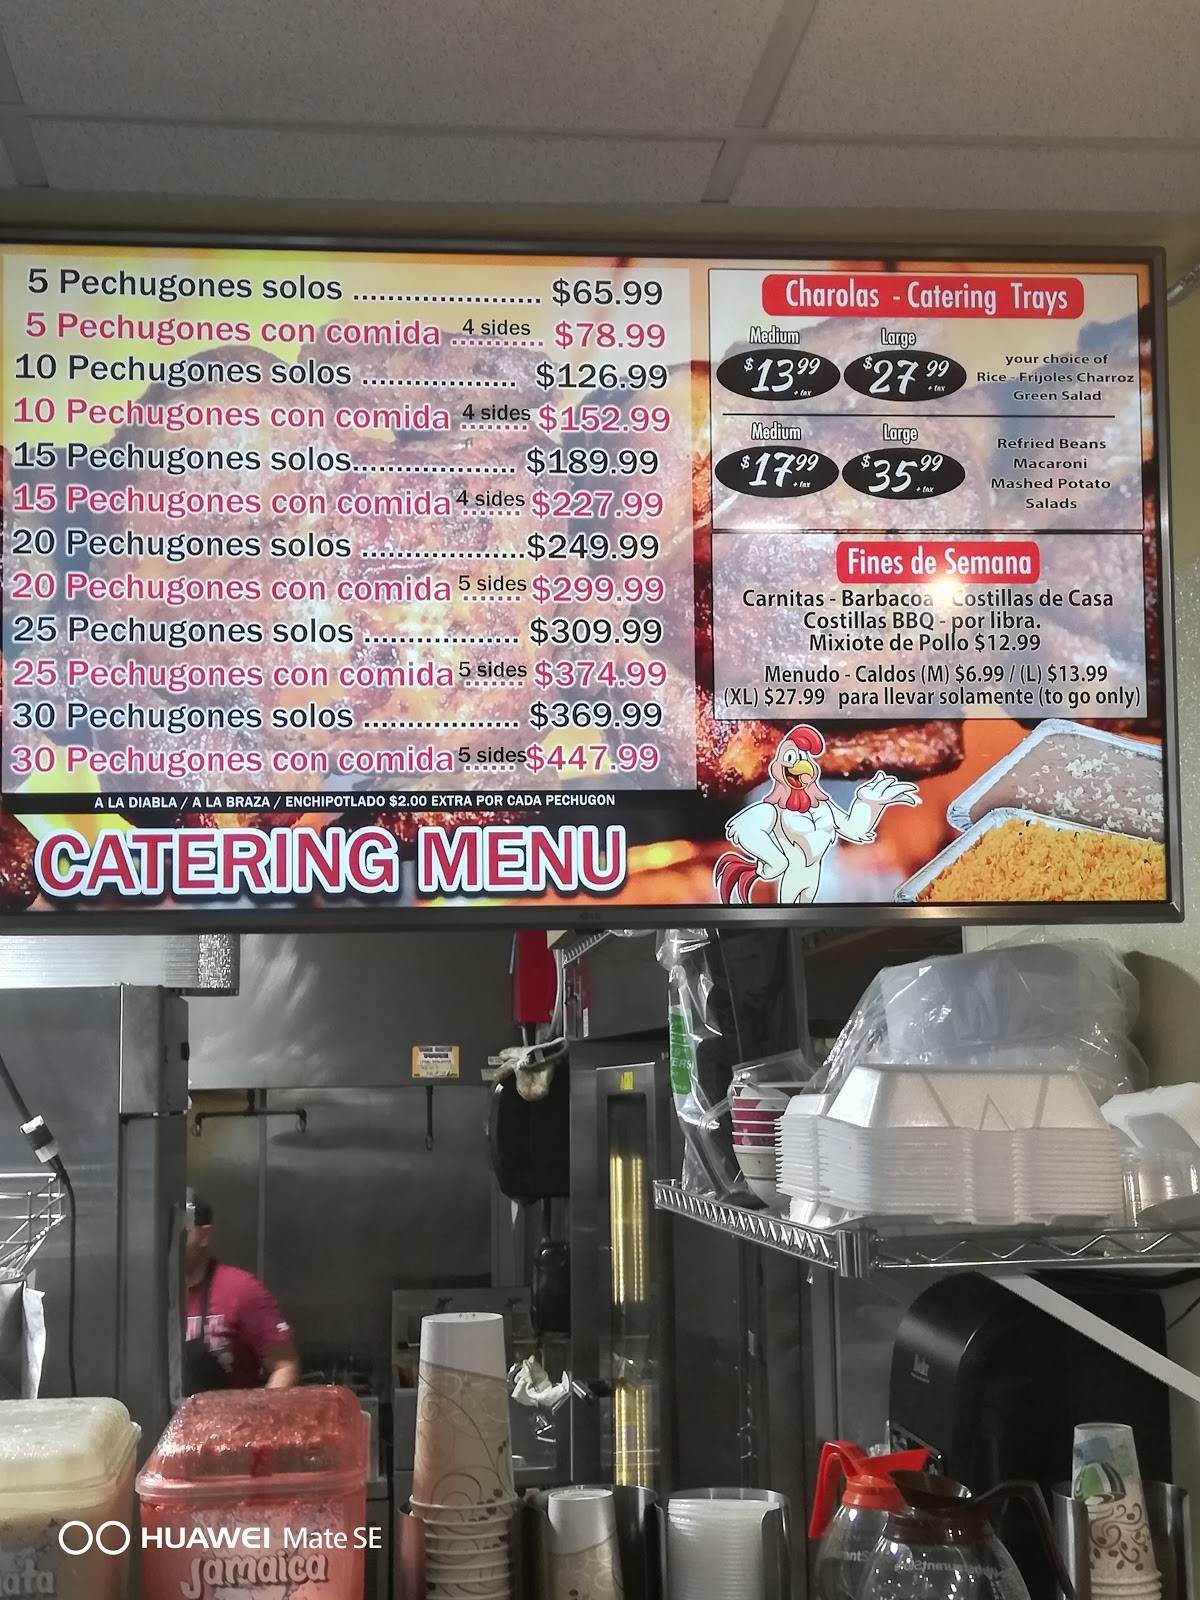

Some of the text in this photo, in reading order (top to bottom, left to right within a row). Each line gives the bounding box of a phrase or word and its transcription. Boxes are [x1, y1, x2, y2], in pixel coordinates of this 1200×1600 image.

[27, 268, 663, 308] 5 Pechugones solos $65.99
[786, 279, 1068, 315] Charolas Catering Trays
[26, 312, 666, 349] 5 Pechugones con comida 4 sides $78.99
[750, 326, 800, 345] Medium
[881, 328, 916, 348] Large
[1006, 354, 1108, 365] your choice of
[14, 355, 668, 390] 10 Pechugones solos $126.99
[977, 372, 1134, 384] Rice Frijoles Charroz
[1013, 391, 1102, 400] Green Salad
[13, 395, 670, 433] 10 Pechugones con comida 4 sides $152.99
[751, 423, 802, 440] Medium
[883, 424, 918, 444] Large
[998, 438, 1106, 449] Refried Beans
[13, 440, 56, 466] 15
[66, 441, 261, 474] Pechugones
[527, 448, 658, 475] $189.99
[1013, 458, 1088, 469] Macaroni
[991, 478, 1111, 489] Mashed Potato
[13, 483, 663, 518] 15 Pechugones con comida 4 sides $227.99
[1026, 498, 1077, 509] Salads
[12, 528, 659, 561] 20 Pechugones solos $249.99
[848, 545, 1031, 575] Fines de Semana
[12, 572, 664, 606] 20 Pechugones con comida 5 sides $299.99
[743, 589, 1113, 607] Carnitas Barbacoa Costillas de Casa
[12, 615, 662, 648] 25 Pechugones solos $309.99
[804, 612, 1041, 634] Costillas BBQ por libra.
[810, 633, 1041, 652] Mixiote de Pollo $12.99
[12, 659, 667, 692] 25 Pechugones con comida 5 sides $374.99
[765, 665, 840, 682] Menudo
[855, 665, 916, 682] Caldos
[921, 665, 949, 685] (M)
[955, 664, 1004, 684] $6.99
[1020, 665, 1042, 684] (L)
[1047, 664, 1108, 684] $13.99
[724, 687, 1141, 709] (XL) $27.99 para llevar solamente (to go only)
[11, 701, 662, 734] 30 Pechugones solos $369.99
[11, 744, 660, 778] 30 Pechugones con comida 5 sides $447.99
[94, 798, 104, 808] A
[108, 798, 124, 808] LA
[129, 797, 177, 808] DIABLA
[192, 797, 201, 808] A
[206, 797, 222, 808] LA
[227, 797, 270, 807] BRAZA
[286, 795, 386, 807] ENCHIPOTLADO
[389, 796, 427, 807] $2.00
[431, 795, 472, 806] EXTRA
[476, 795, 503, 806] POR
[507, 795, 542, 806] CADA
[546, 794, 616, 805] PECHUGON
[34, 825, 627, 897] CATERING MENU
[180, 1551, 329, 1599] Jamaica
